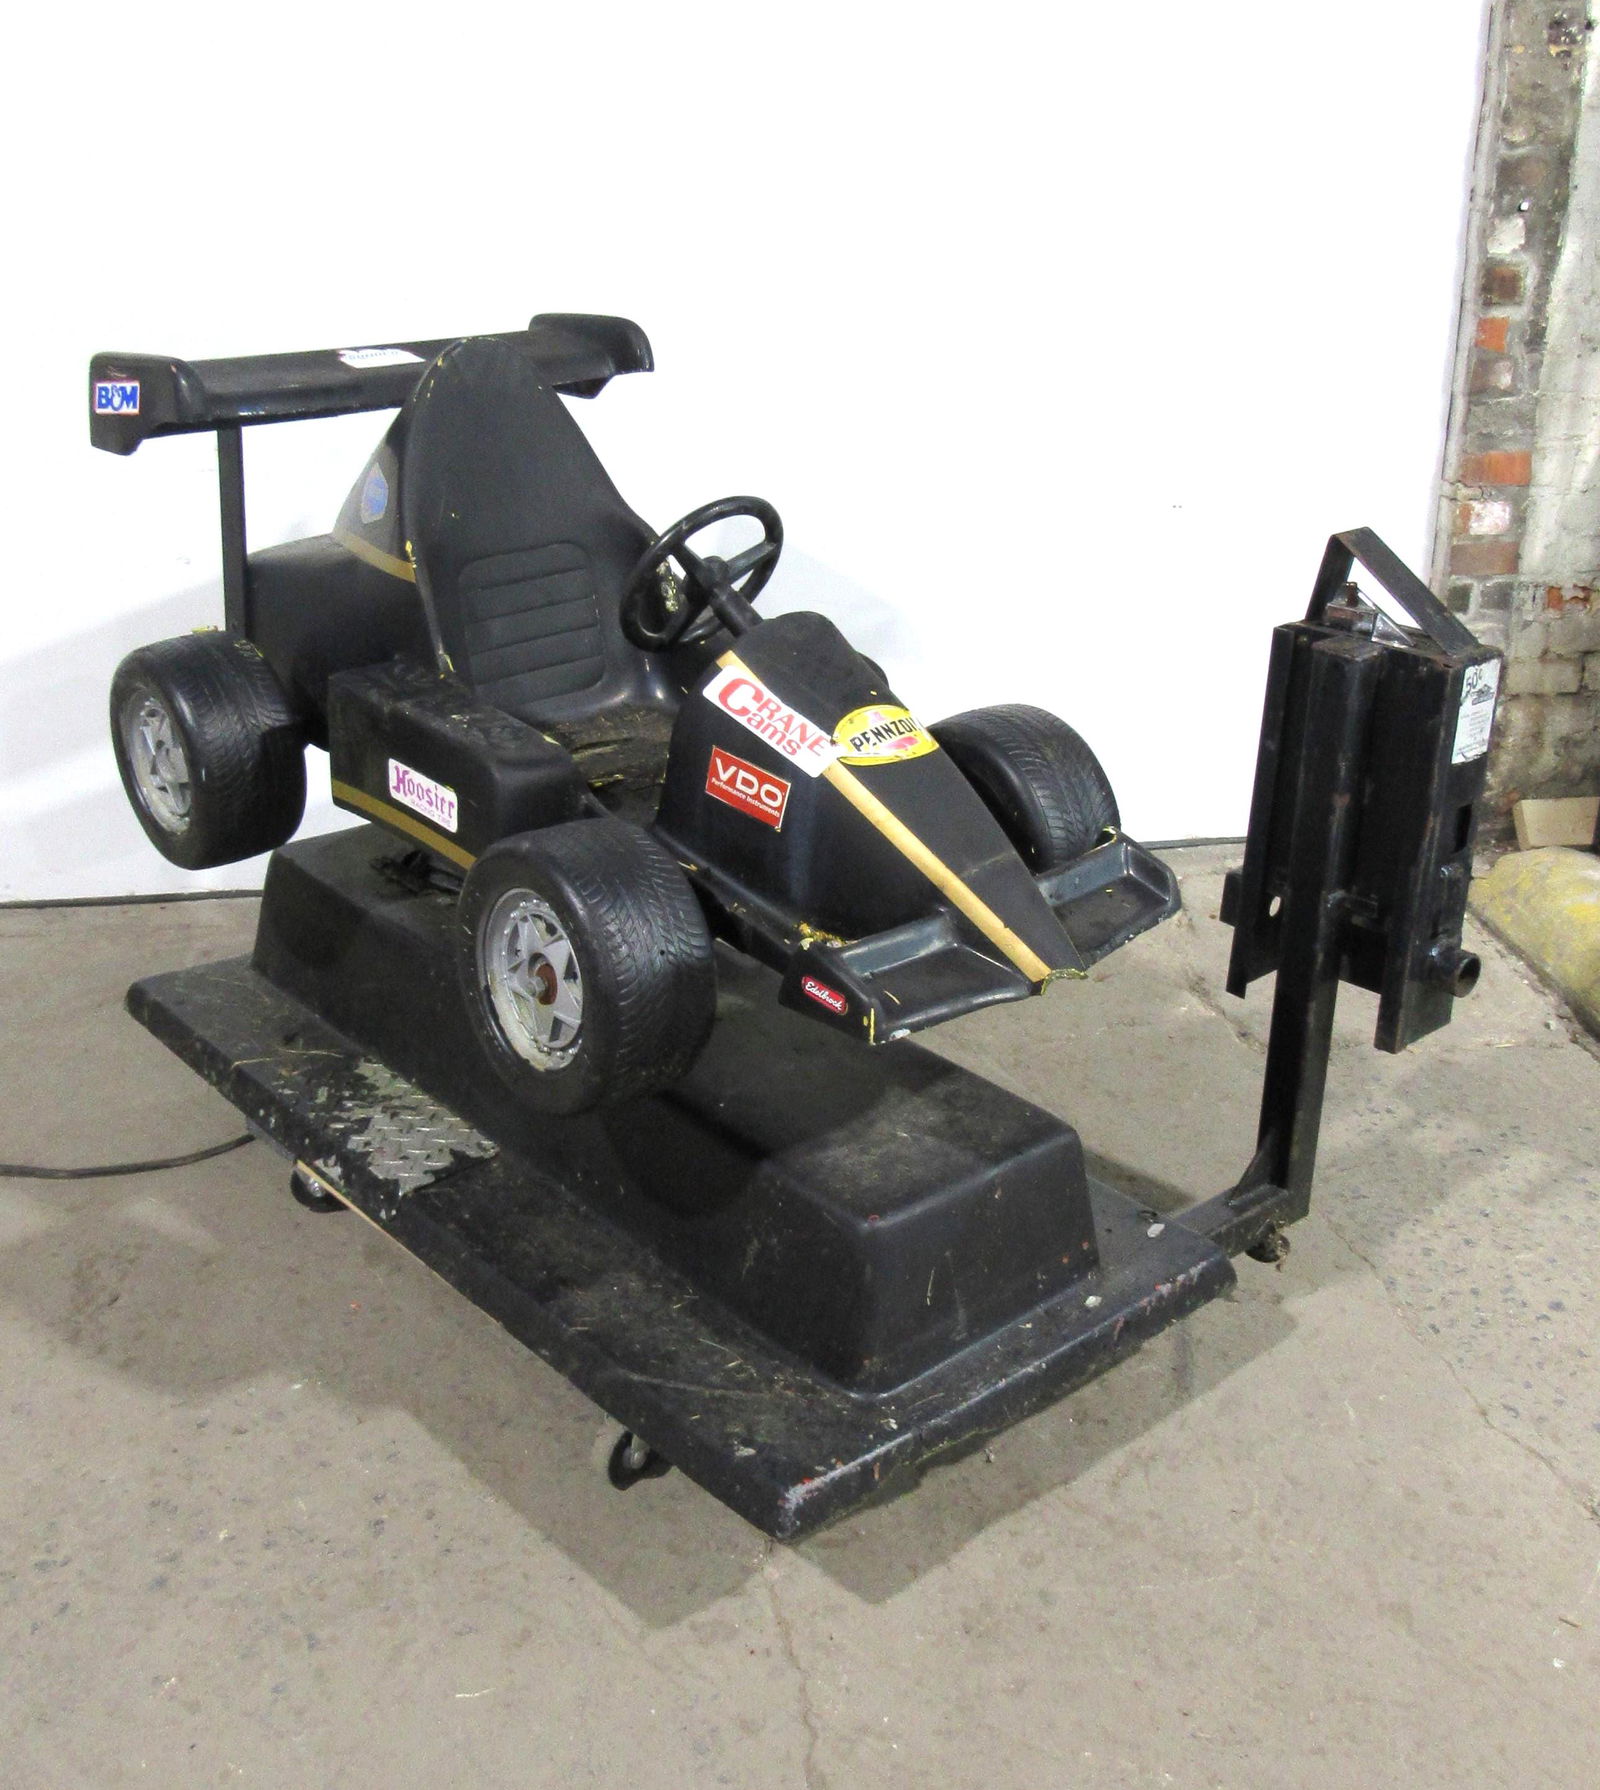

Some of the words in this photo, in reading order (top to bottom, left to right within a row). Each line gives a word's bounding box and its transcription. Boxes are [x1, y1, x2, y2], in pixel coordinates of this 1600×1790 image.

[718, 677, 830, 757] CRANE
[392, 765, 454, 819] Hoosier
[711, 777, 746, 800] Performance
[746, 795, 780, 818] Instruments
[715, 757, 783, 808] VDO
[805, 981, 842, 1011] Edelbrock
